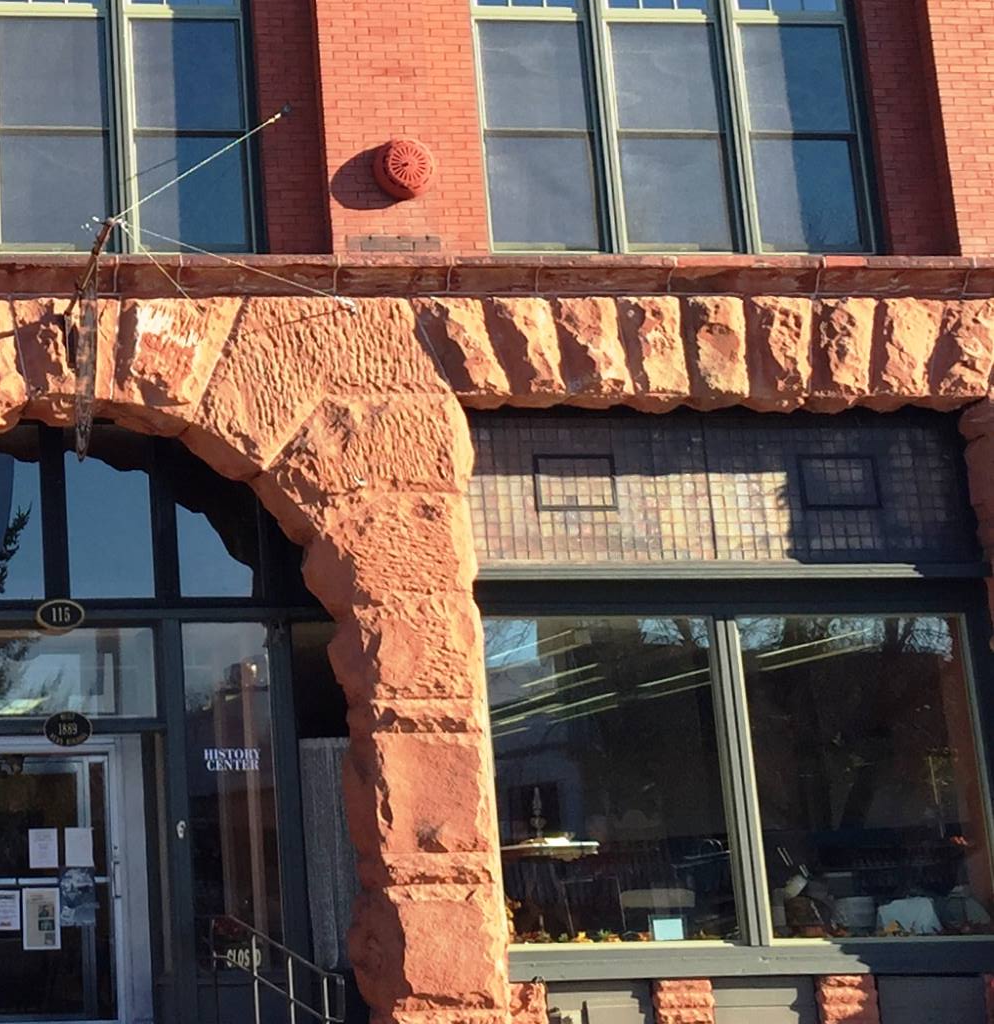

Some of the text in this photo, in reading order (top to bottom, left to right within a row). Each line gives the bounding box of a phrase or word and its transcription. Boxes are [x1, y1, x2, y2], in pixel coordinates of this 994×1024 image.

[51, 607, 71, 623] 115
[204, 748, 261, 760] HISTORY
[206, 759, 260, 771] CENTER
[226, 948, 262, 967] CLOSD
